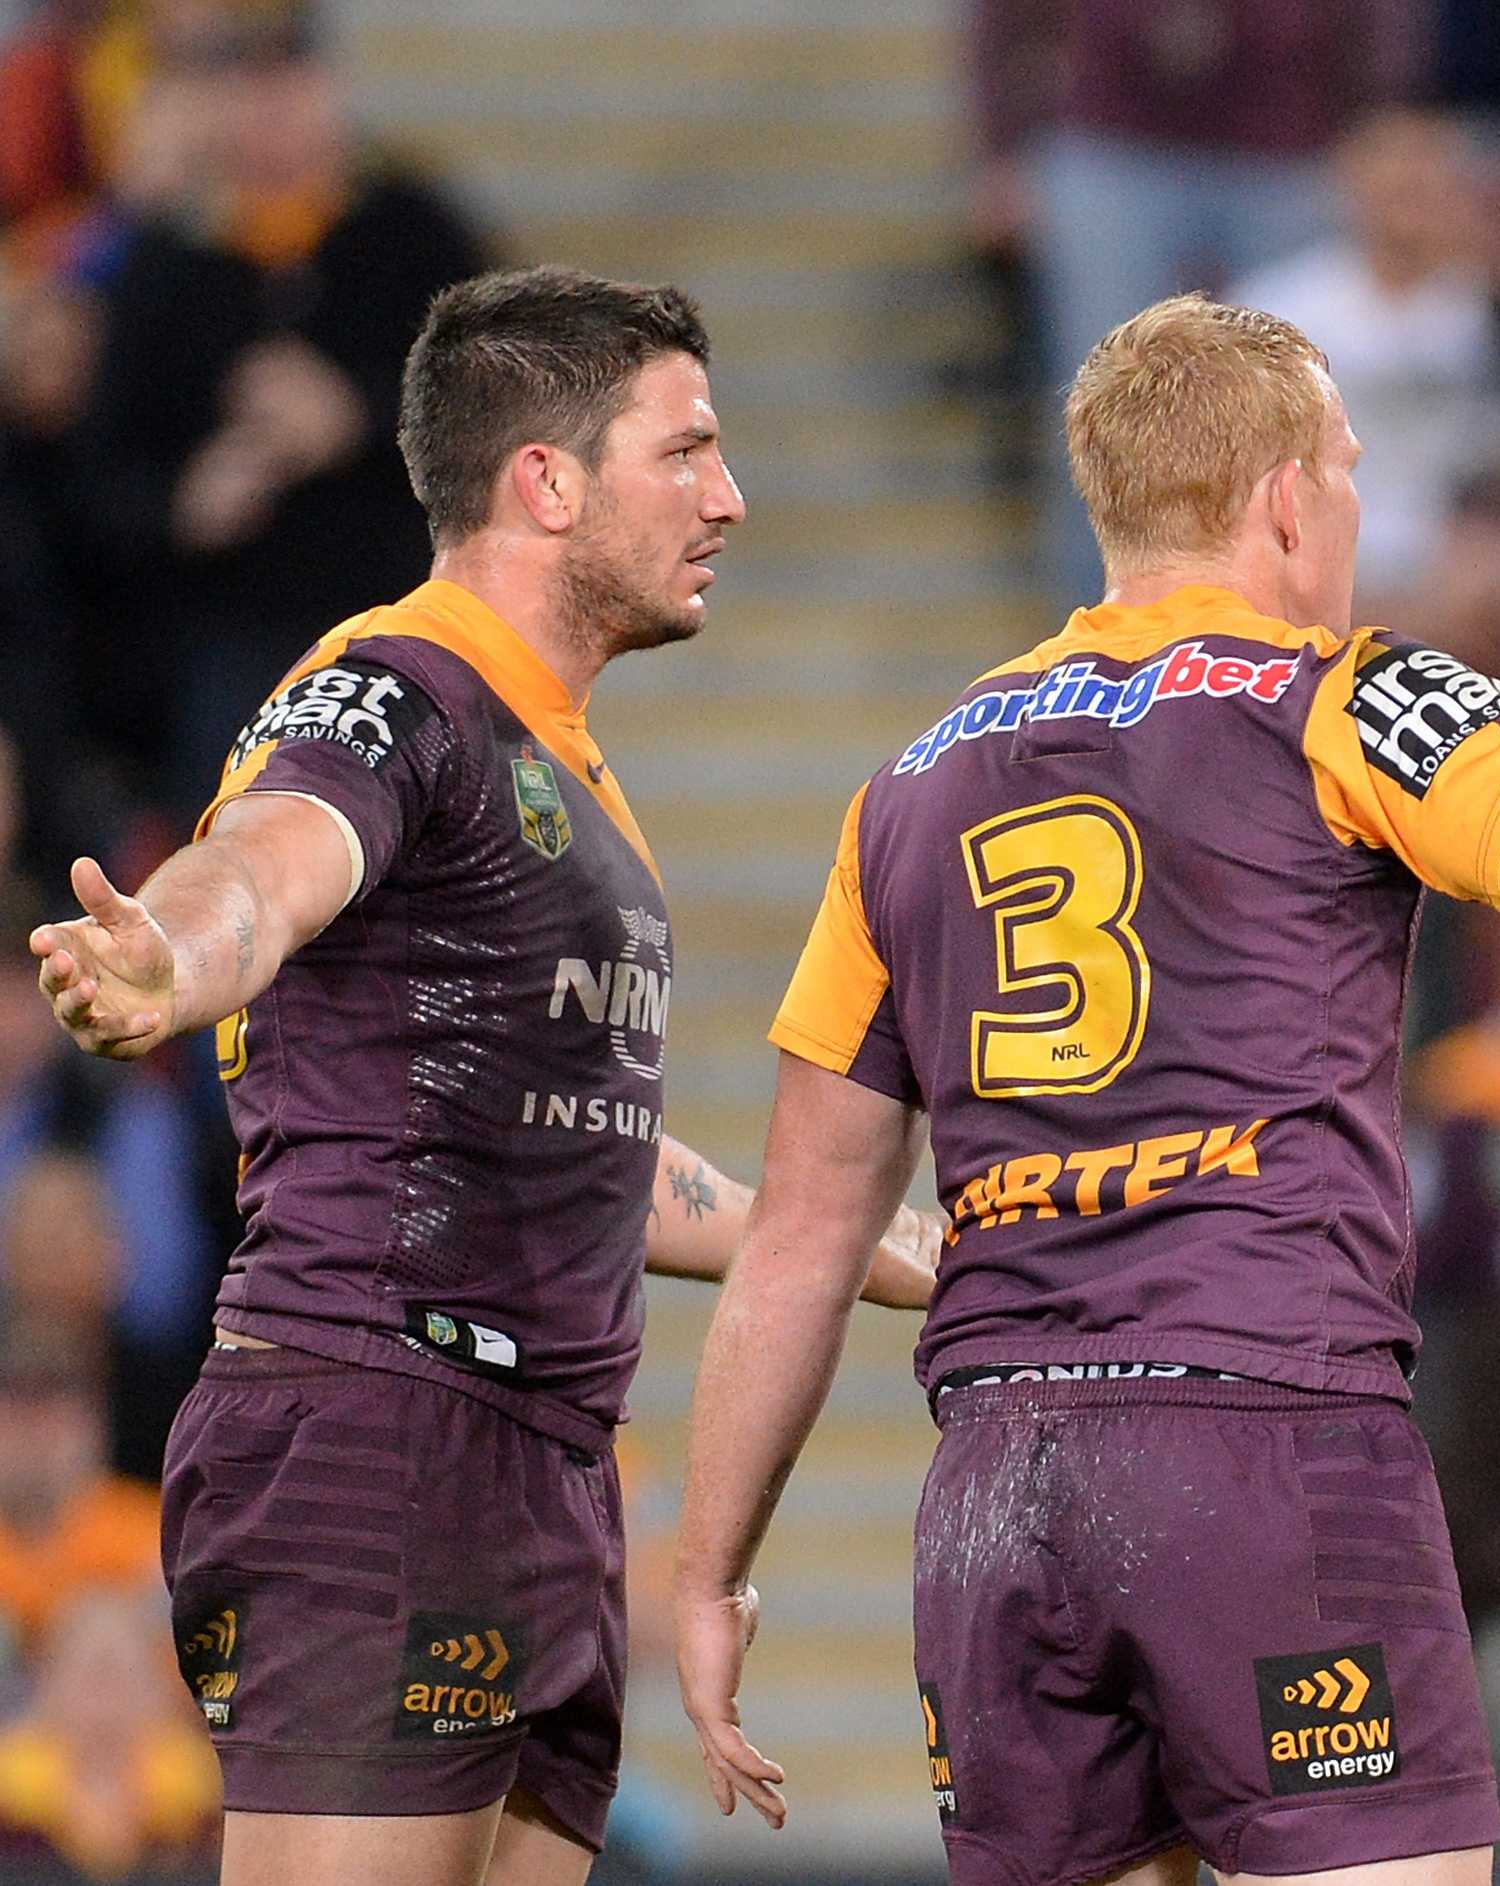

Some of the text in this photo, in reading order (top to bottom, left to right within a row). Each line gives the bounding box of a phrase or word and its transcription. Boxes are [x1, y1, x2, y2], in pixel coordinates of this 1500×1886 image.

[893, 641, 1302, 776] sportingbet
[282, 724, 381, 769] SAVINGS
[1414, 722, 1477, 788] LOANS
[960, 793, 1151, 1099] 3
[548, 957, 672, 1040] NRM
[1051, 1042, 1091, 1062] NRL
[522, 1091, 663, 1146] INSURA
[403, 1682, 513, 1719] arrow
[1271, 1717, 1390, 1761] arrow
[1307, 1751, 1395, 1779] energy
